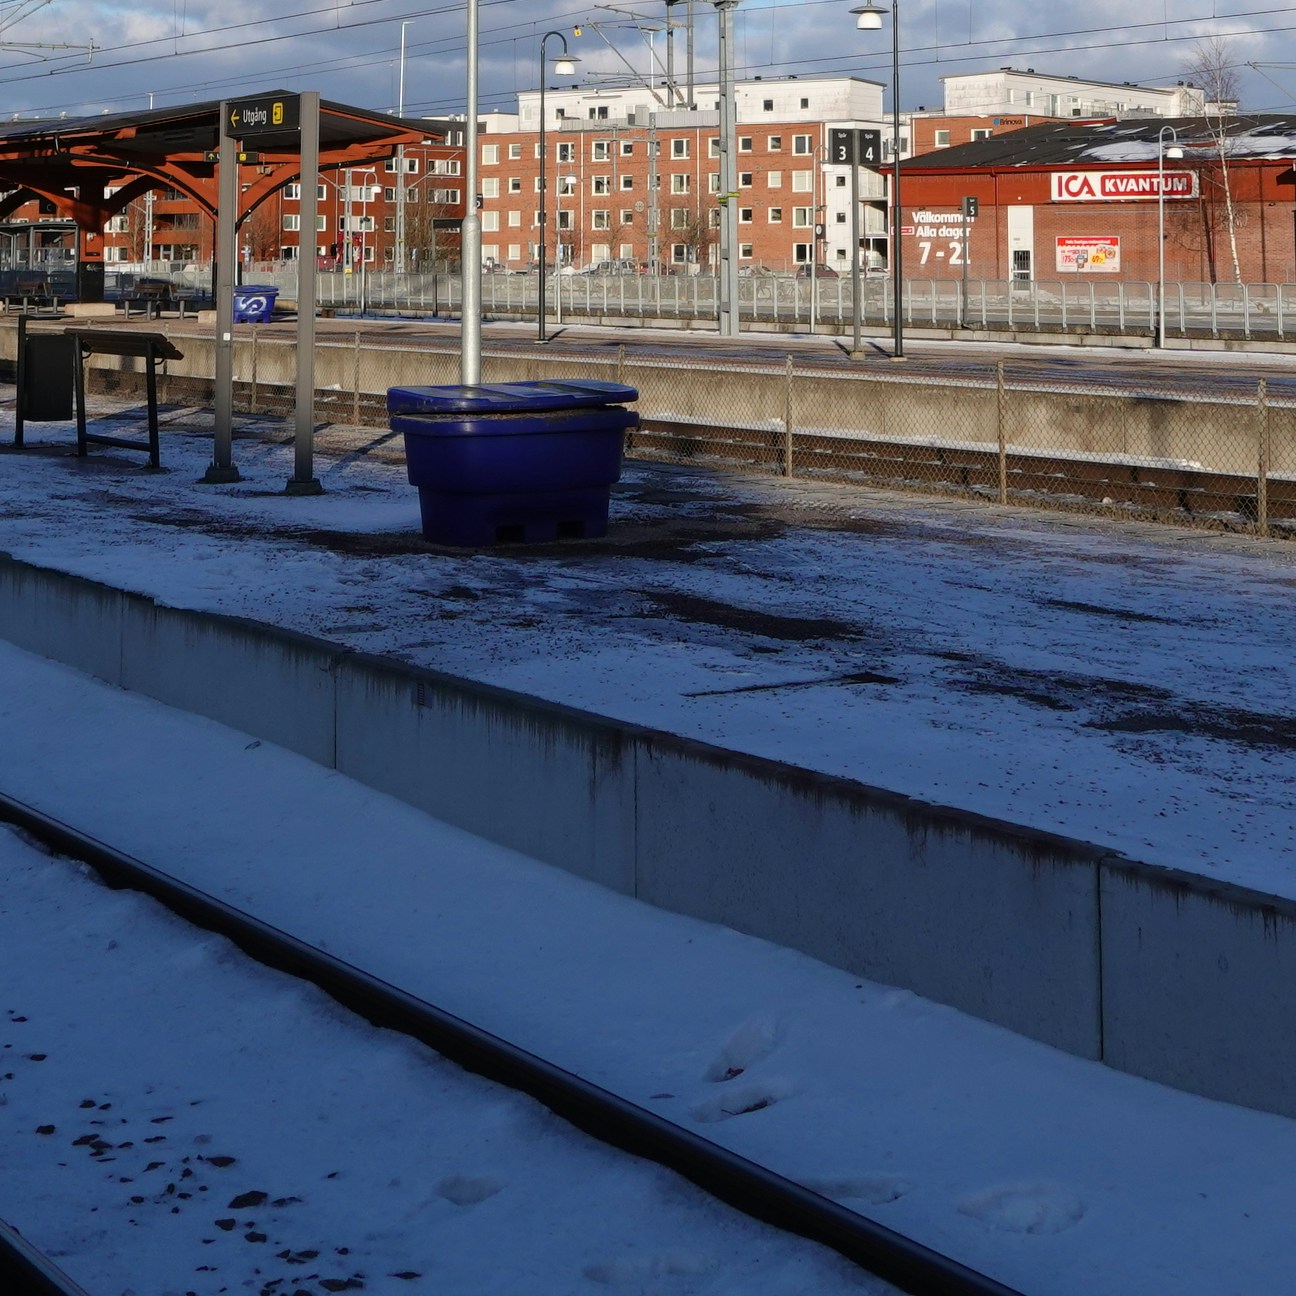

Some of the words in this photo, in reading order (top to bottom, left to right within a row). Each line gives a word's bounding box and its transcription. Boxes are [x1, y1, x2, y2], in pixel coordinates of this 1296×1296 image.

[243, 106, 267, 126] Utgång
[1000, 118, 1023, 126] Brinova
[838, 145, 847, 161] 3
[865, 146, 874, 161] 4
[1057, 174, 1097, 198] ICA
[1105, 177, 1188, 192] KVANTUM
[970, 206, 975, 215] 5
[915, 226, 937, 237] Alla
[919, 242, 931, 265] 7
